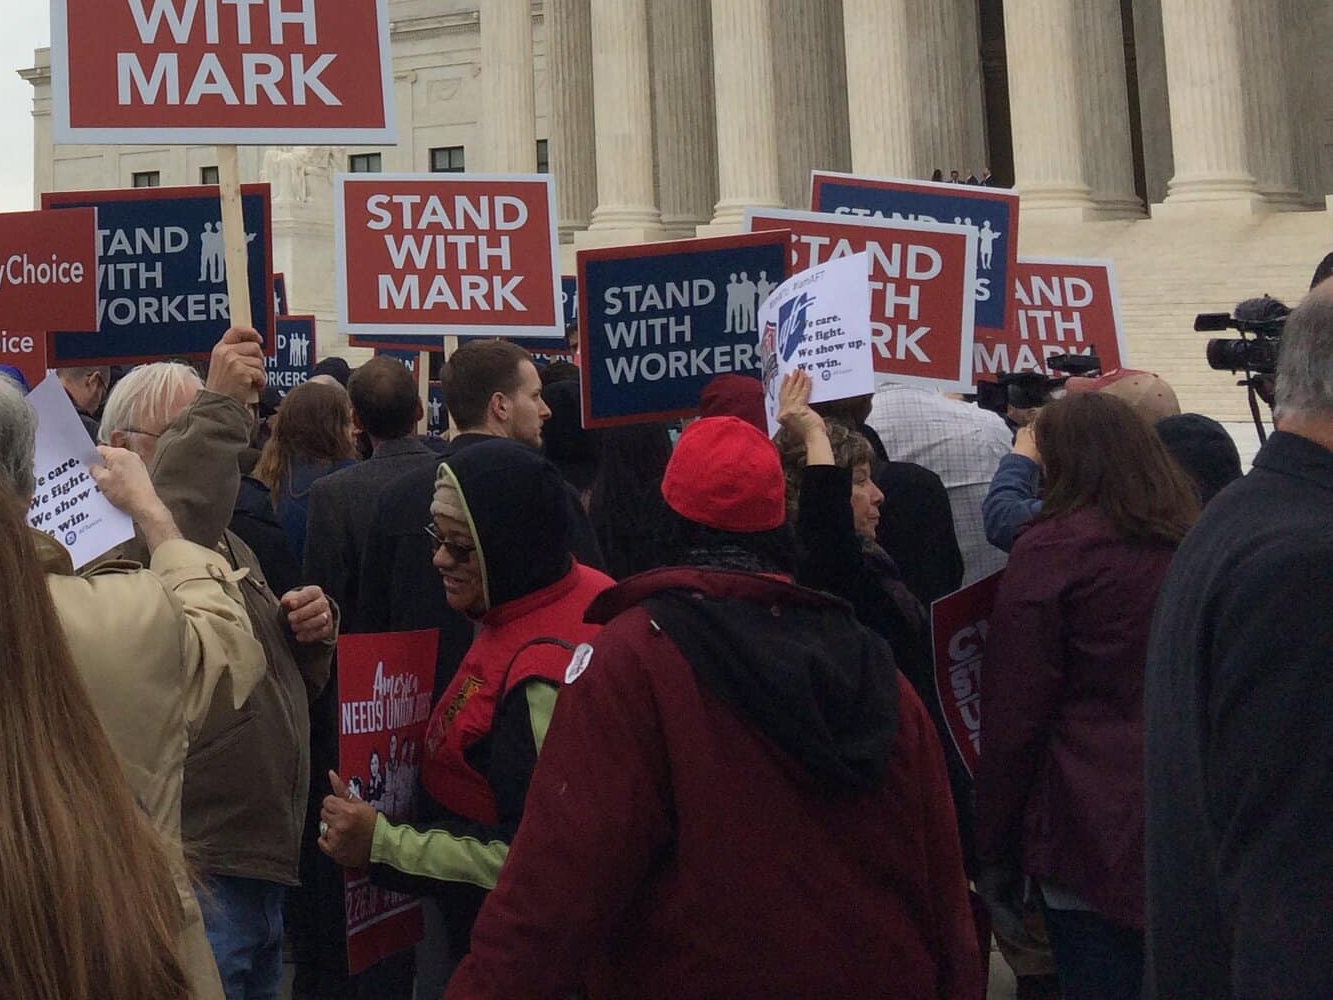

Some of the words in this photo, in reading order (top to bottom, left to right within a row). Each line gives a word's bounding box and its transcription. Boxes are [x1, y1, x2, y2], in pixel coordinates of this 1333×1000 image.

[117, 53, 343, 106] MARK
[366, 194, 529, 231] STAND
[97, 225, 189, 257] TAND
[384, 234, 512, 271] WITH
[378, 274, 528, 312] MARK
[604, 278, 716, 317] STAND
[1015, 275, 1094, 308] AND
[98, 293, 231, 327] ORKER
[815, 315, 841, 326] care.
[1018, 309, 1084, 342] ITH
[604, 315, 692, 351] WITH
[797, 349, 814, 358] We
[815, 343, 845, 355] show
[848, 340, 866, 350] up.
[814, 328, 846, 342] fight.
[816, 359, 841, 369] win.
[48, 457, 80, 481] care.
[51, 471, 90, 499] fight.
[30, 510, 52, 528] We
[54, 489, 91, 516] show
[59, 512, 89, 532] win.
[342, 700, 384, 735] NEEDS
